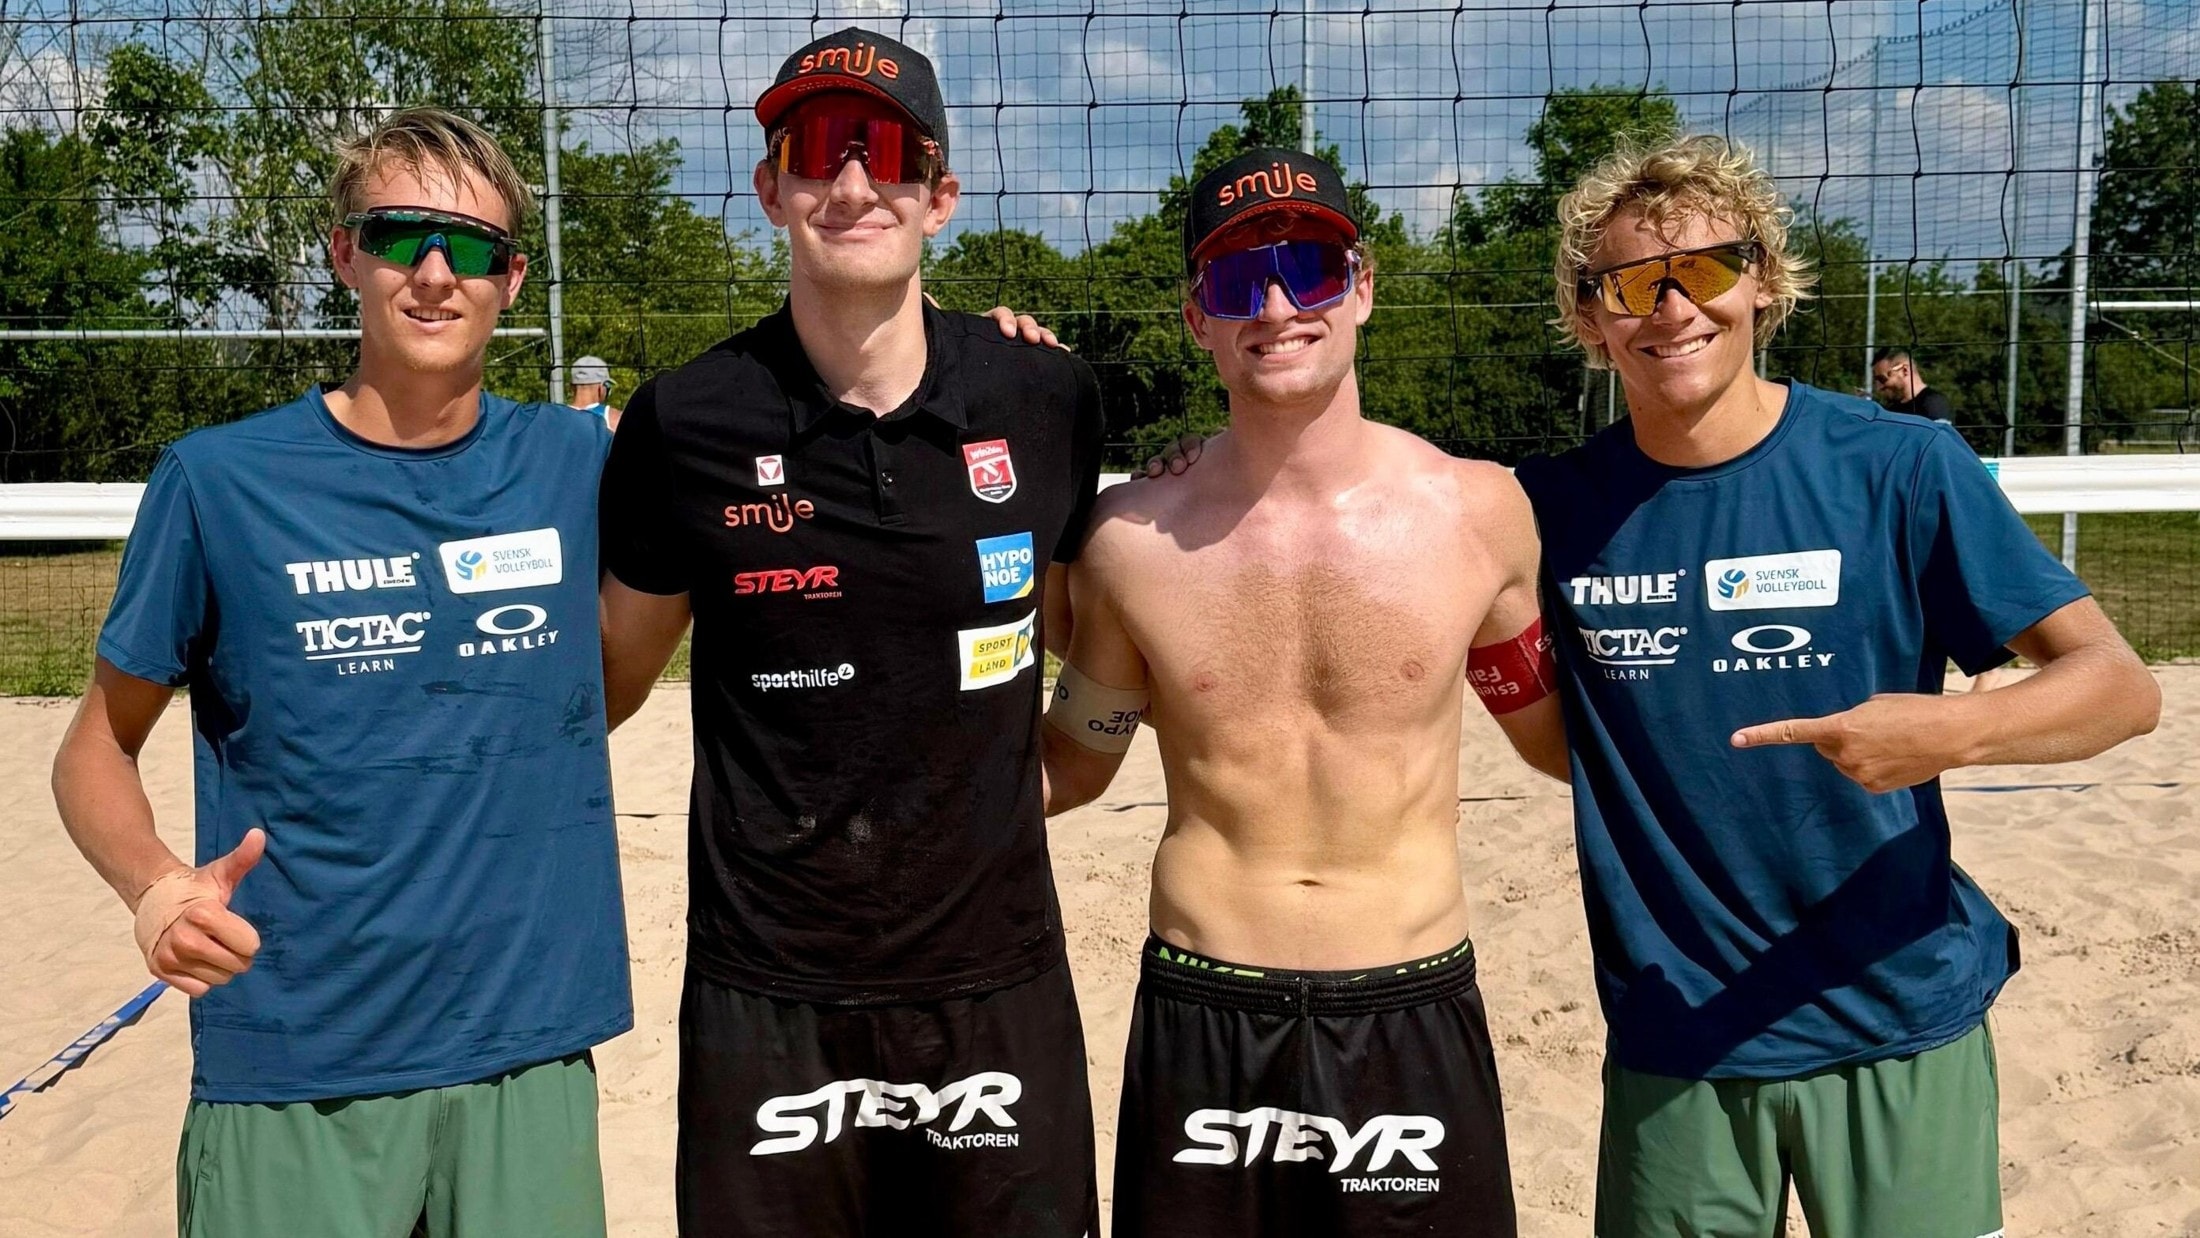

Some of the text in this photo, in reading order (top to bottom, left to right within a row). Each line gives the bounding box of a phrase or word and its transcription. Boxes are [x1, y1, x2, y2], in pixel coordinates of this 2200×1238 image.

[798, 42, 899, 80] smile
[1218, 162, 1317, 206] smile
[724, 493, 815, 533] smile
[493, 548, 532, 562] SVENSK
[494, 557, 554, 575] VOLLEYBOLL
[981, 548, 1032, 570] HYPO
[286, 556, 416, 595] THULE
[735, 566, 839, 594] STEYR
[984, 567, 1021, 588] NOE
[1756, 568, 1800, 581] SVENSK
[1570, 573, 1677, 605] THULE
[1756, 579, 1828, 593] VOLLEYBOLL
[296, 611, 426, 652] TICTAC
[459, 630, 559, 657] OAKLEY
[979, 637, 1013, 653] SPORT
[337, 659, 395, 676] LEARN
[979, 659, 1006, 674] LAND
[1713, 653, 1834, 673] OAKLEY
[751, 668, 839, 692] sporthilfe
[1604, 669, 1649, 680] LEARN
[750, 1071, 1022, 1155] STEYR
[925, 1127, 1019, 1150] TRAKTOREN
[1172, 1106, 1446, 1173] STEYR
[1340, 1177, 1440, 1193] TRAKTOREN
